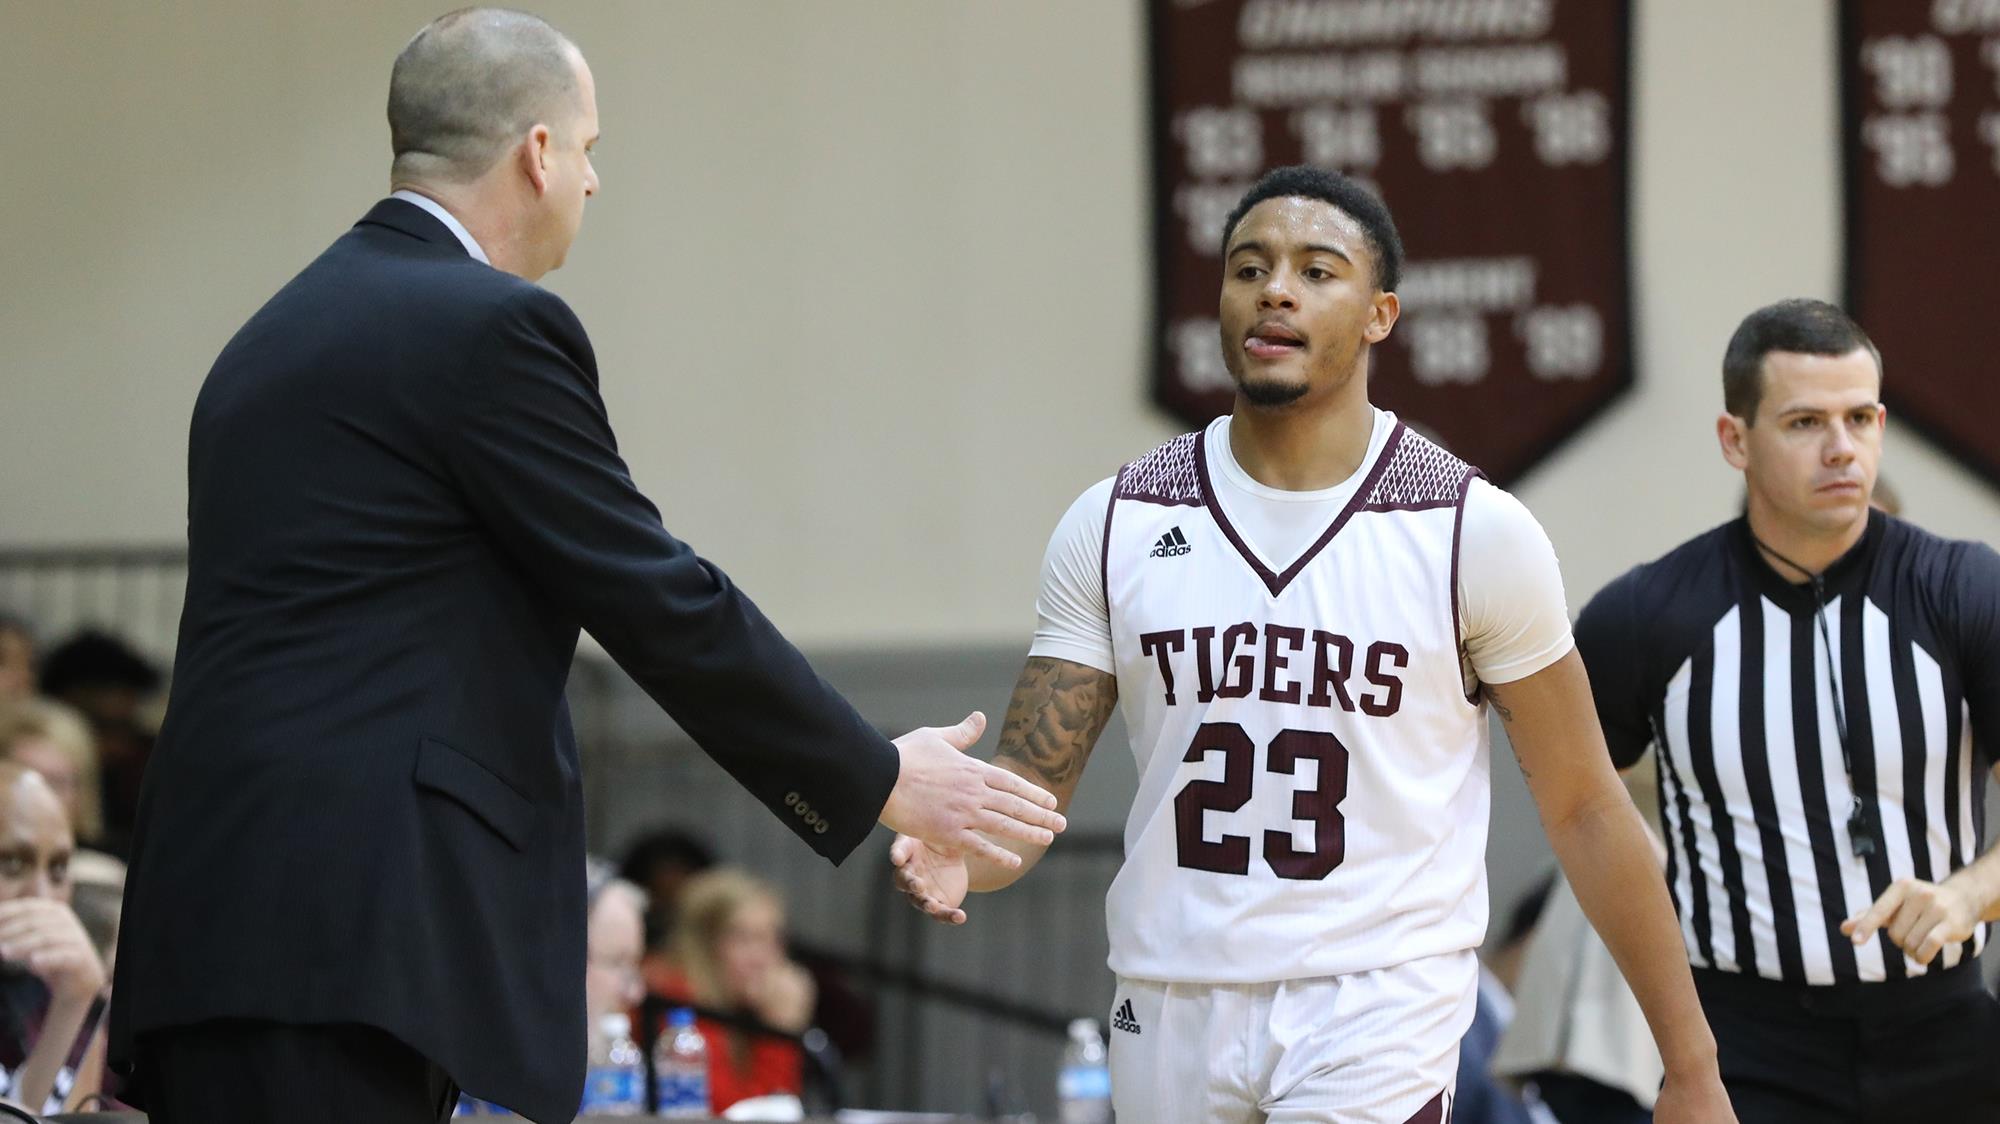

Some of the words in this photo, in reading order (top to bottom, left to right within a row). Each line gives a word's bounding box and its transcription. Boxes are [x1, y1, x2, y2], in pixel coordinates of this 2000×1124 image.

[1150, 544, 1192, 558] adidas
[1140, 621, 1410, 718] TIGERS
[1174, 721, 1350, 881] 23
